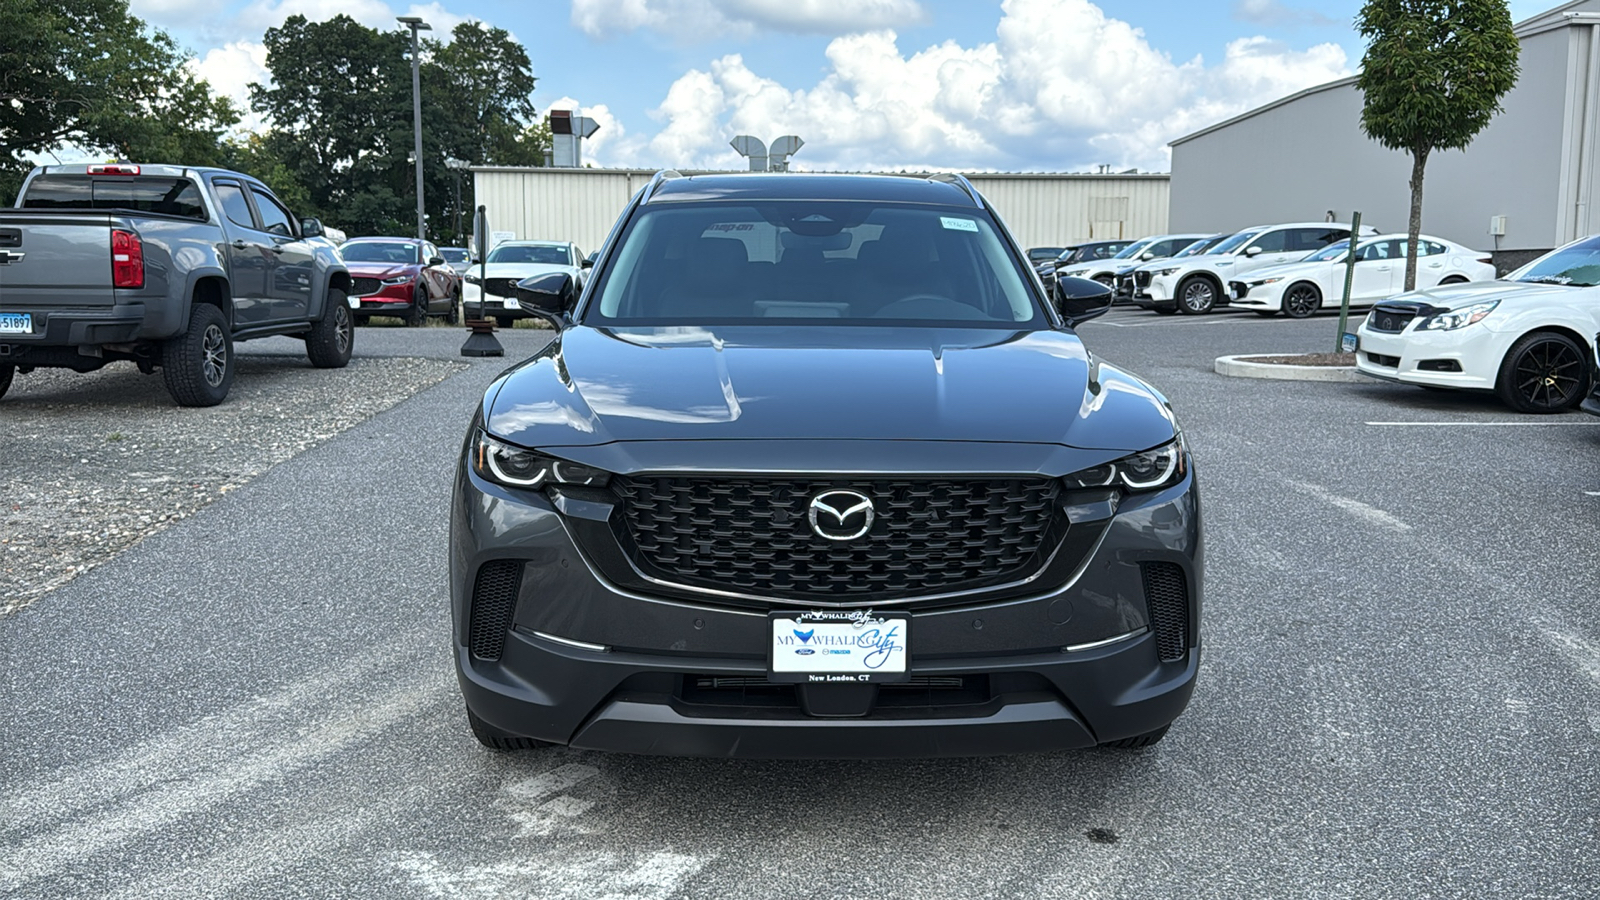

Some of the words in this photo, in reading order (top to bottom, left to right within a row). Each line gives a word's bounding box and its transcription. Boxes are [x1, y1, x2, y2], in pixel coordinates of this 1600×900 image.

[777, 635, 795, 646] MY
[812, 635, 876, 646] WHALING
[857, 626, 903, 669] City
[808, 674, 825, 682] New
